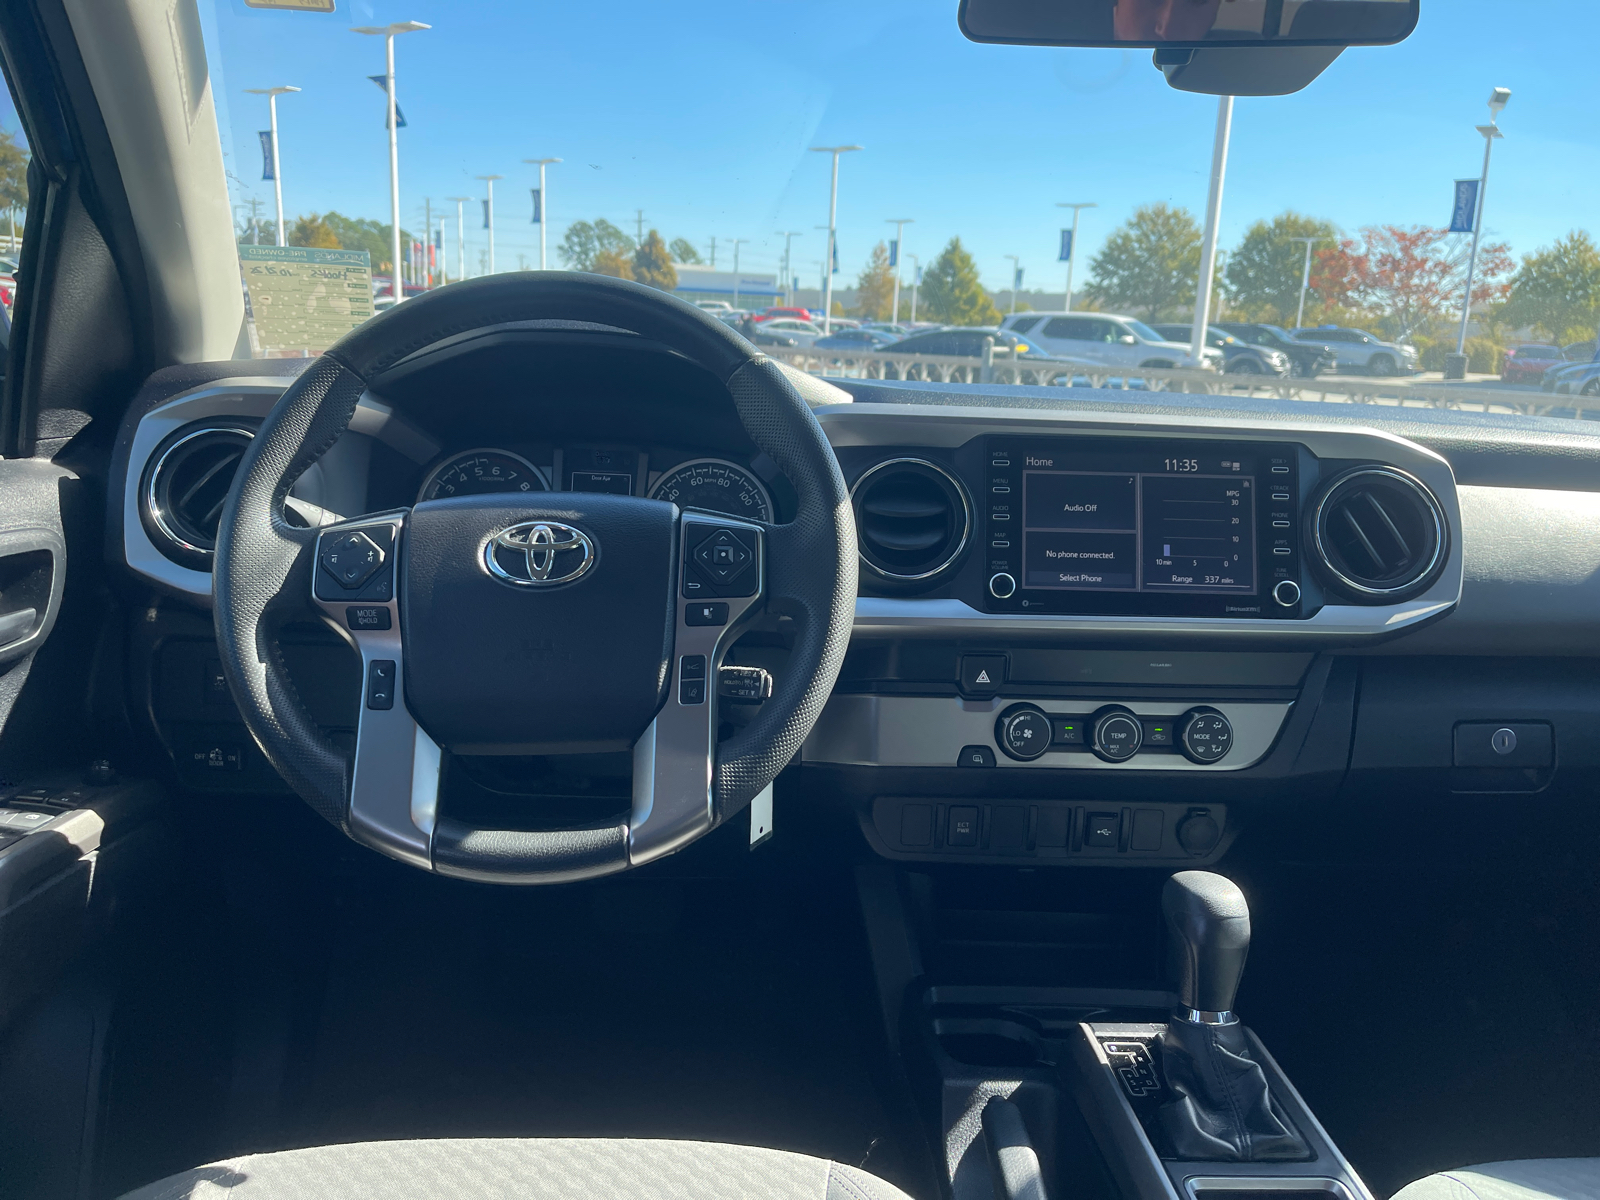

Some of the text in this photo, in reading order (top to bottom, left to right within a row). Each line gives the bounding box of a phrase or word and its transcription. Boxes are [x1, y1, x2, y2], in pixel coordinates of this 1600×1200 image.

[1026, 456, 1054, 467] Home
[1164, 459, 1198, 472] 11:35
[474, 467, 483, 476] 5
[491, 466, 500, 475] 6
[460, 473, 468, 482] 4
[508, 471, 518, 480] 7
[690, 476, 704, 487] 60
[717, 476, 730, 489] 80
[445, 484, 455, 494] 3
[520, 481, 531, 492] 8
[668, 488, 680, 502] 40
[740, 491, 753, 506] 100
[1063, 504, 1097, 512] Audio Off
[1046, 550, 1115, 559] No phone connected.
[1193, 559, 1197, 567] 5
[1059, 574, 1102, 583] Select Phone
[1172, 575, 1193, 584] Range
[356, 610, 377, 618] MODE
